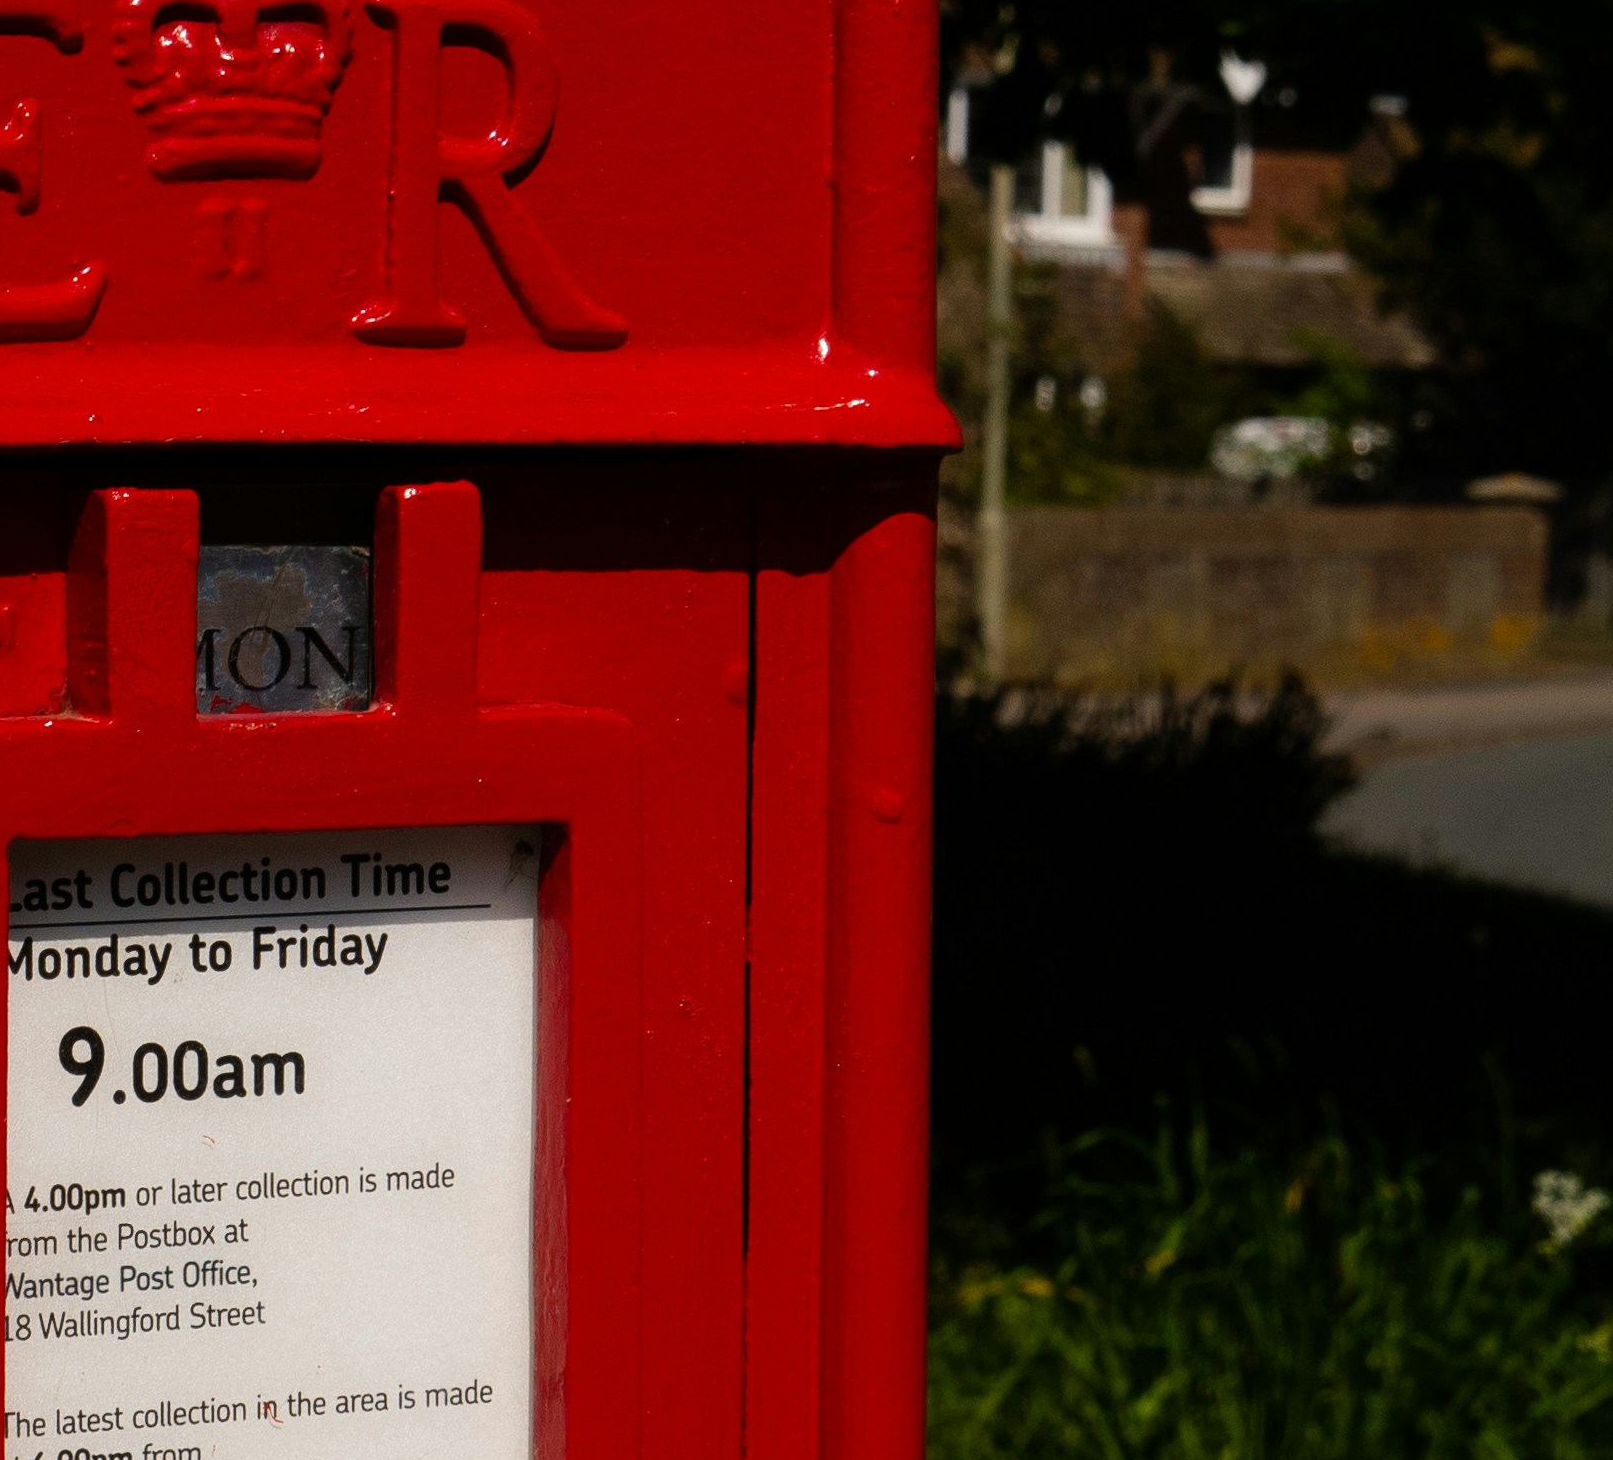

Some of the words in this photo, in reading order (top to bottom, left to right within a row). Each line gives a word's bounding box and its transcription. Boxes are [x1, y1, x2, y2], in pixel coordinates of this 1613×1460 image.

[110, 858, 327, 908] Collection
[341, 852, 451, 897] Time
[189, 935, 233, 973] to
[252, 924, 389, 975] Friday
[59, 1026, 304, 1107] 9.00am
[24, 1183, 125, 1215] 4.00pm
[136, 1186, 163, 1206] or
[172, 1178, 228, 1204] later
[236, 1170, 348, 1200] collection
[360, 1167, 376, 1192] is
[387, 1162, 454, 1191] made
[7, 1236, 57, 1257] rom
[67, 1226, 107, 1253] the
[118, 1221, 215, 1250] Postbox
[225, 1219, 249, 1243] at
[120, 1266, 174, 1292] Post
[183, 1260, 257, 1287] Office,
[39, 1304, 180, 1340] Wallingford
[190, 1301, 265, 1329] Street
[57, 1408, 124, 1435] latest
[133, 1398, 246, 1428] collection
[255, 1392, 278, 1421] in
[287, 1392, 325, 1417] the
[336, 1393, 388, 1413] area
[399, 1384, 415, 1409] is
[425, 1379, 492, 1407] made
